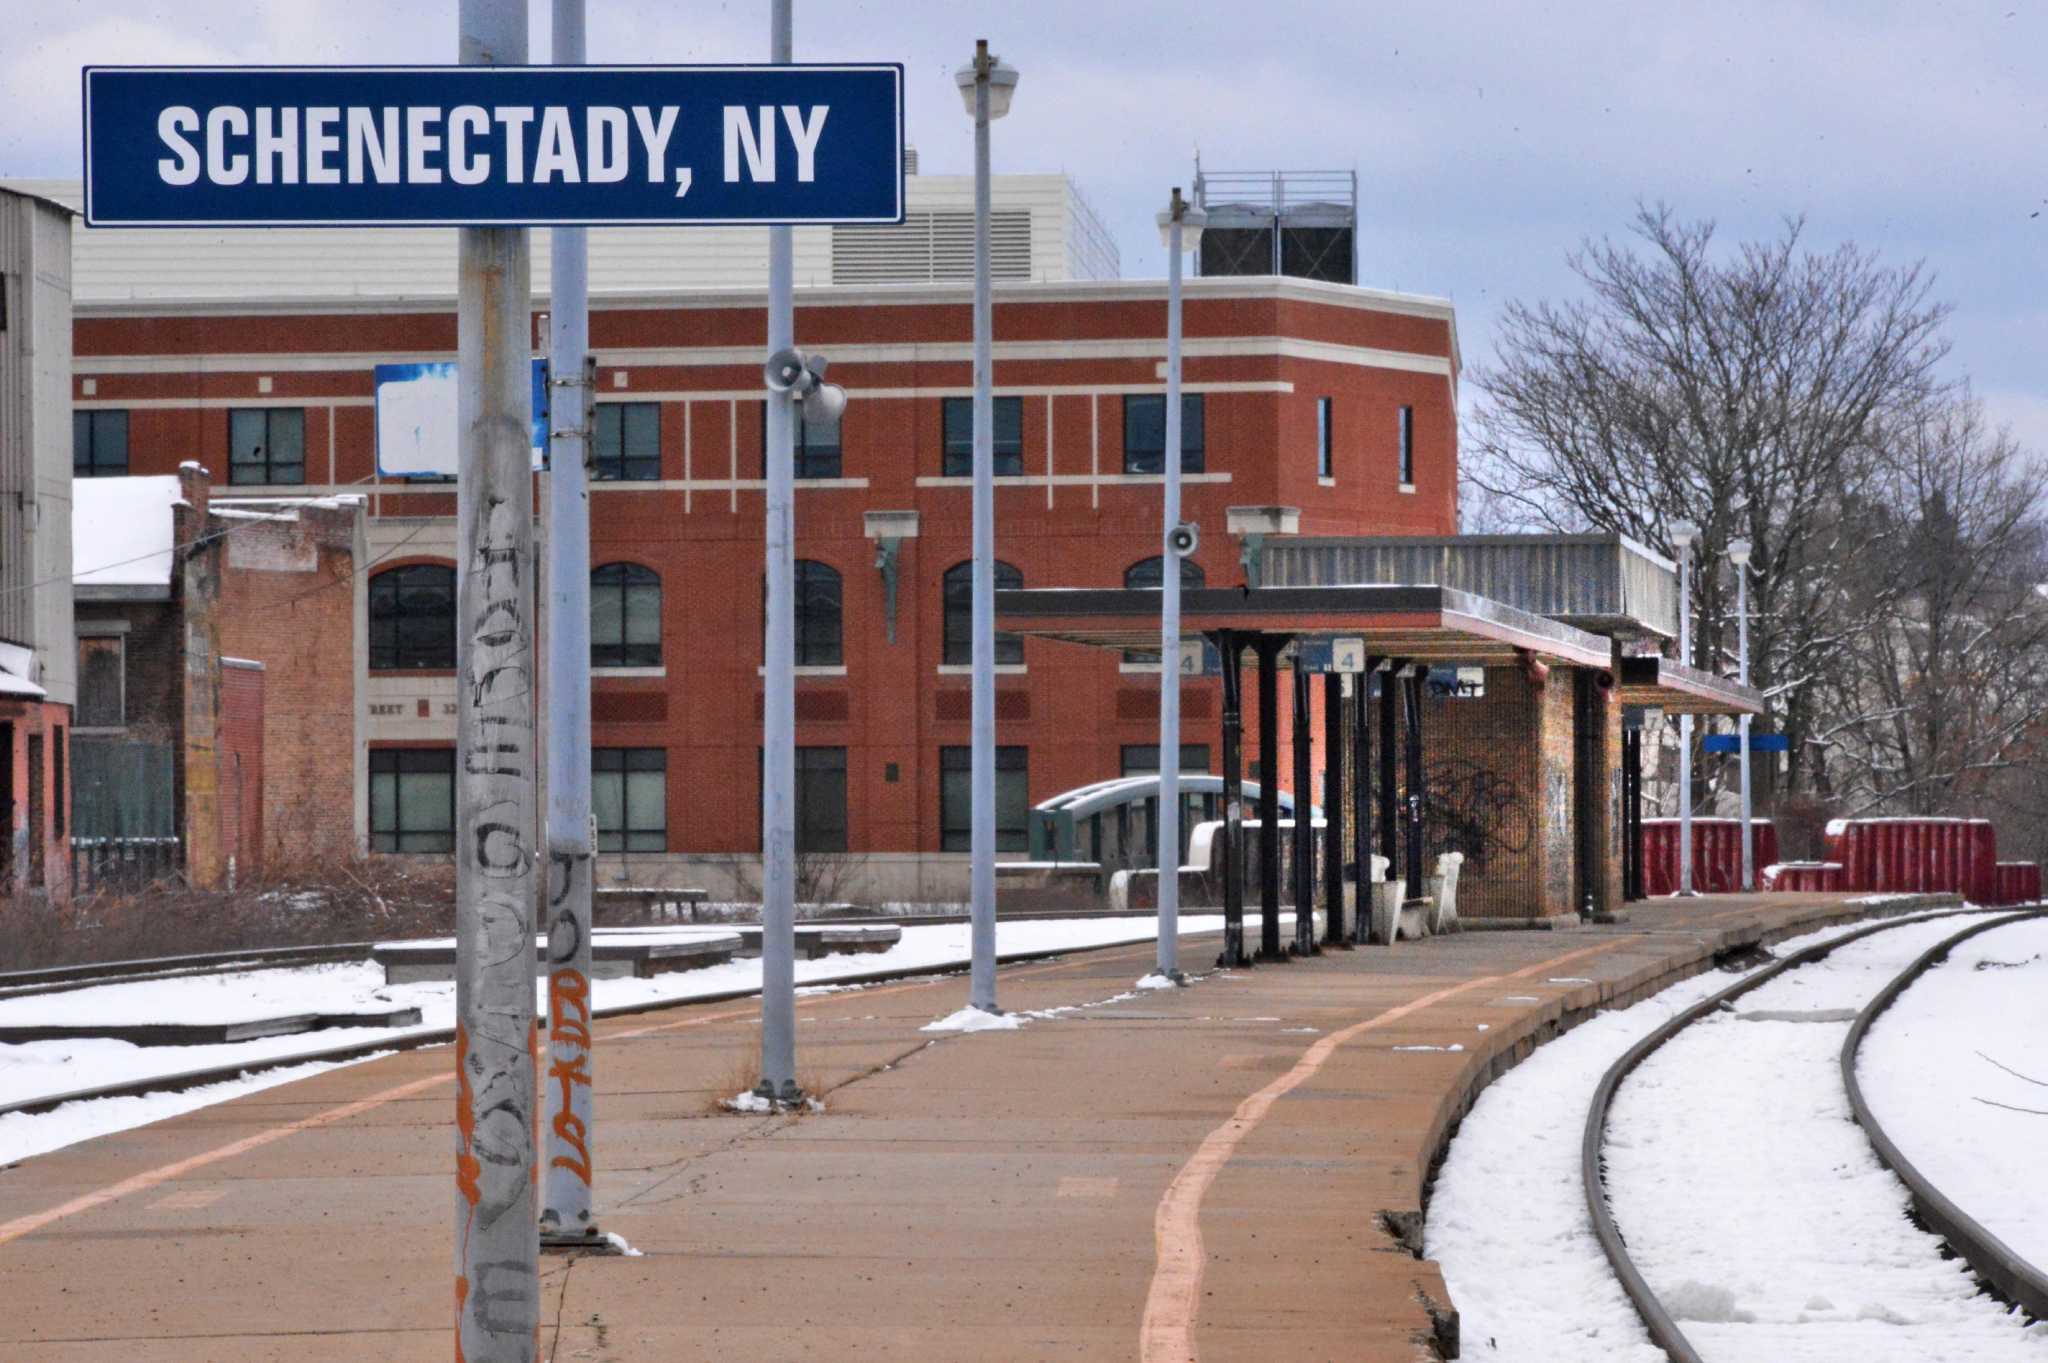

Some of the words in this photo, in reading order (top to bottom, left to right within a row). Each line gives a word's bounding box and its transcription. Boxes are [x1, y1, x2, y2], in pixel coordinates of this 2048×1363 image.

[157, 104, 692, 198] SCHENECTADY,
[723, 104, 830, 183] NY
[1181, 656, 1193, 671] 4
